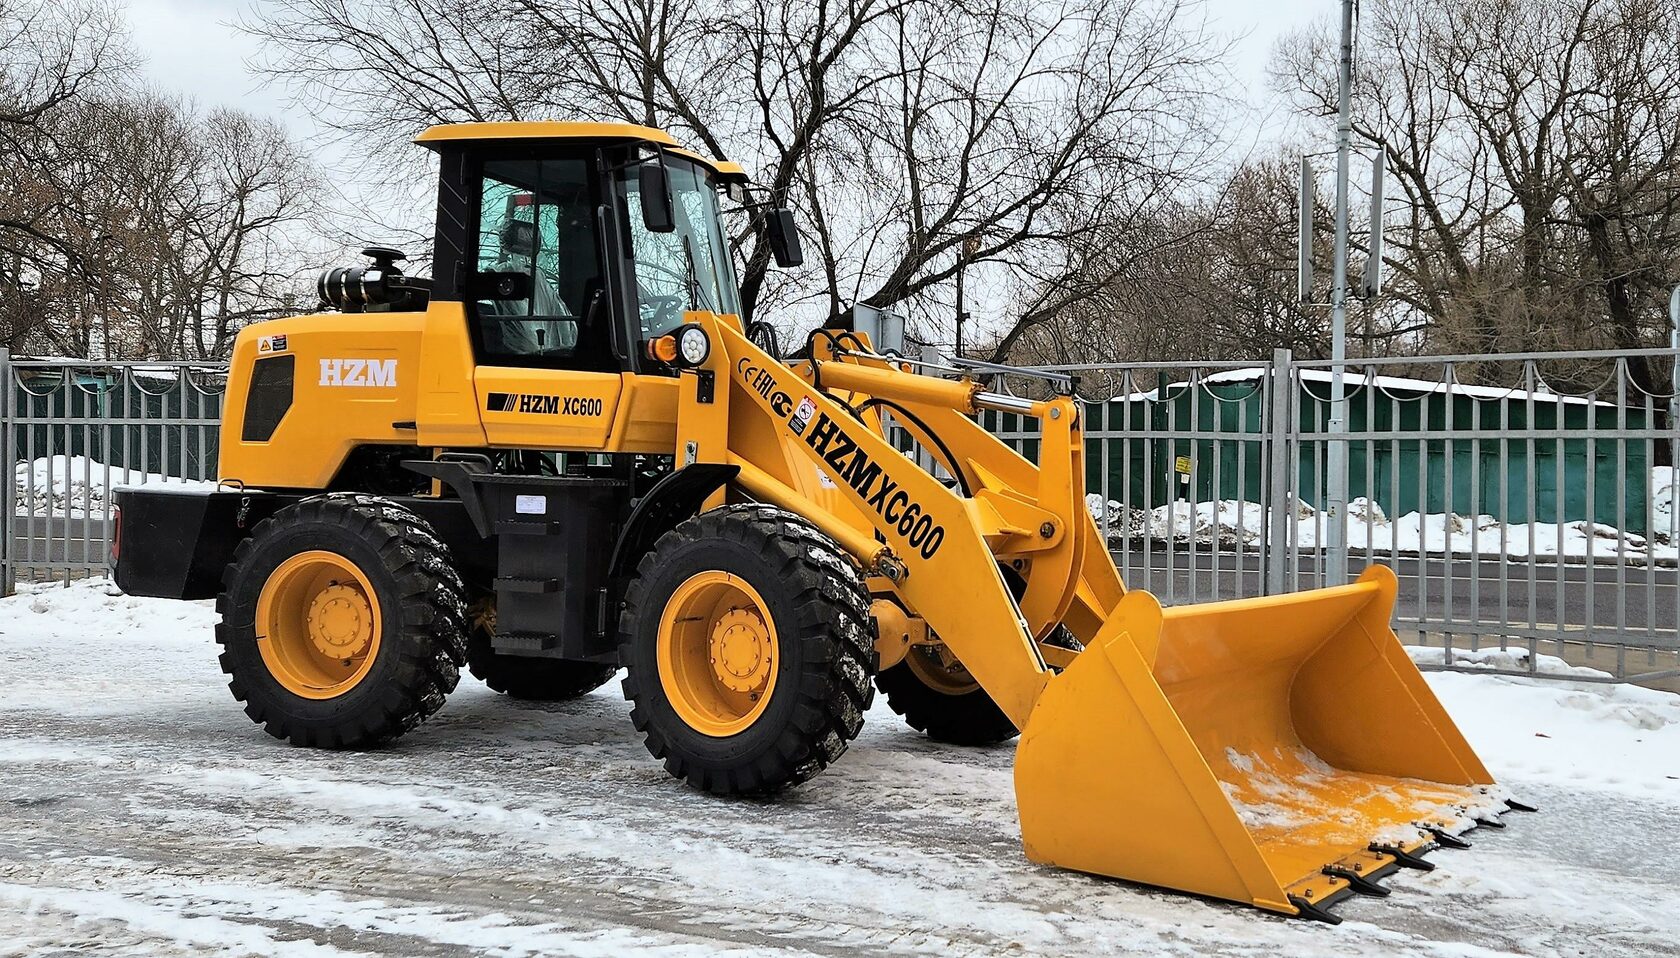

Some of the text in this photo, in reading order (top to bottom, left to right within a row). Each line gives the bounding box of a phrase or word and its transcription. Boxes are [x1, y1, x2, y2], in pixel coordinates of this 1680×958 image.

[319, 359, 398, 386] HZM
[519, 394, 602, 416] HZM XC600
